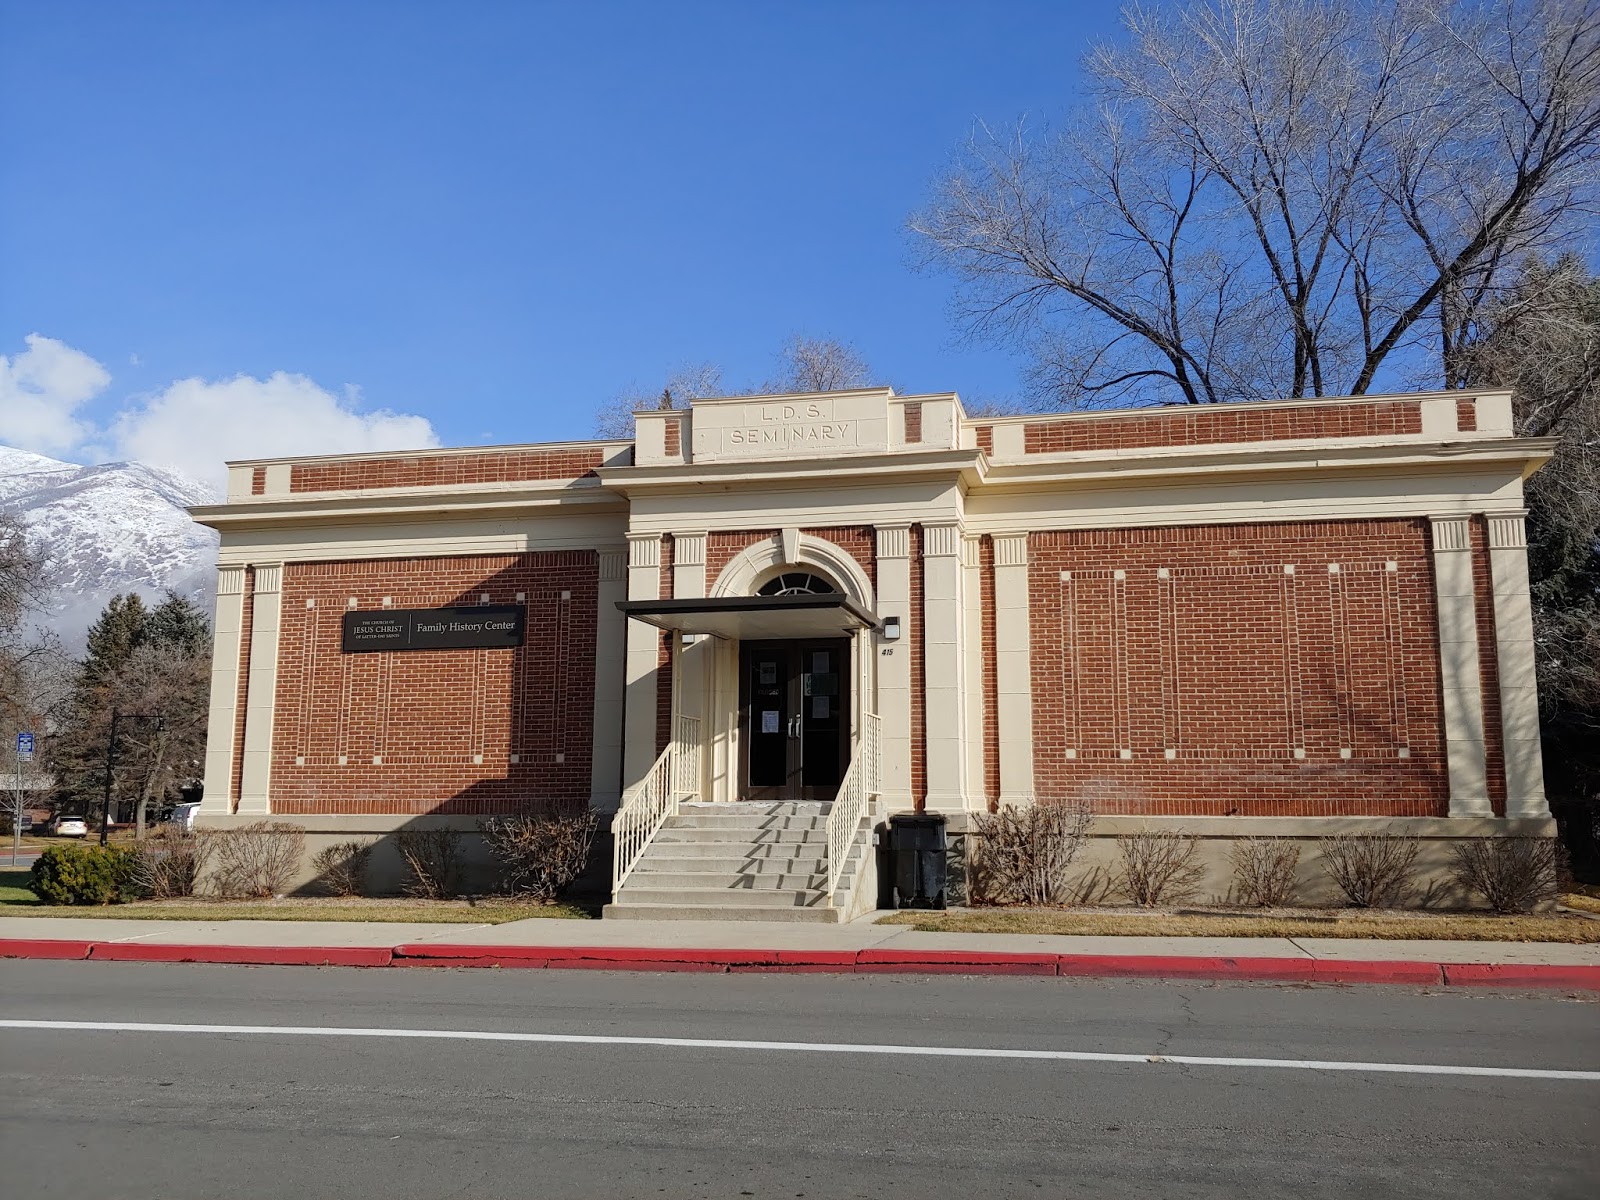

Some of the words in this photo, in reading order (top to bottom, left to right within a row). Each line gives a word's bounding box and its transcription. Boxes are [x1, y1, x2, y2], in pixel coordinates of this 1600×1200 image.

[730, 424, 848, 444] SEMINARY
[353, 626, 374, 635] JESUS
[375, 625, 403, 633] CHRIST
[416, 622, 447, 635] Family
[449, 622, 483, 633] History
[484, 620, 515, 631] Center
[881, 648, 893, 656] 415
